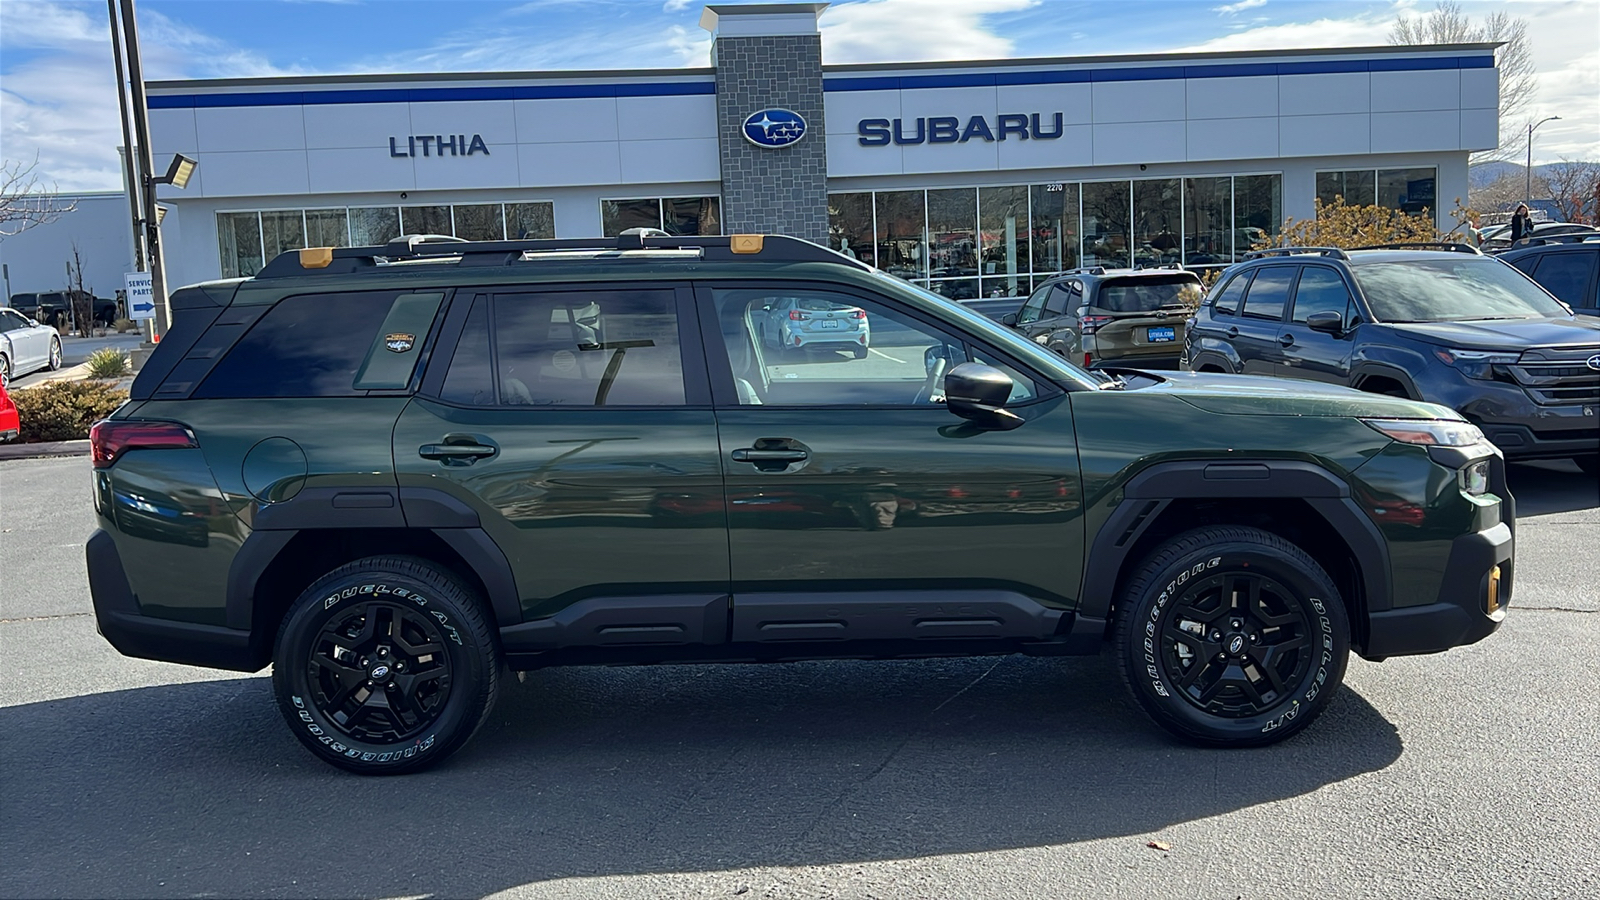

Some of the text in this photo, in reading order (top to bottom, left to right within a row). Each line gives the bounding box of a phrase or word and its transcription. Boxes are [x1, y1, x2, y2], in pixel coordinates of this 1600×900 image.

[389, 134, 490, 157] LITHIA
[858, 112, 1063, 146] SUBARU
[1047, 184, 1063, 192] 2270
[324, 584, 463, 646] DUELER A/T
[1143, 556, 1222, 698] BRIDGESTONE
[1261, 597, 1333, 733] DUELER A/T
[291, 695, 436, 762] BRIDGESTONE
